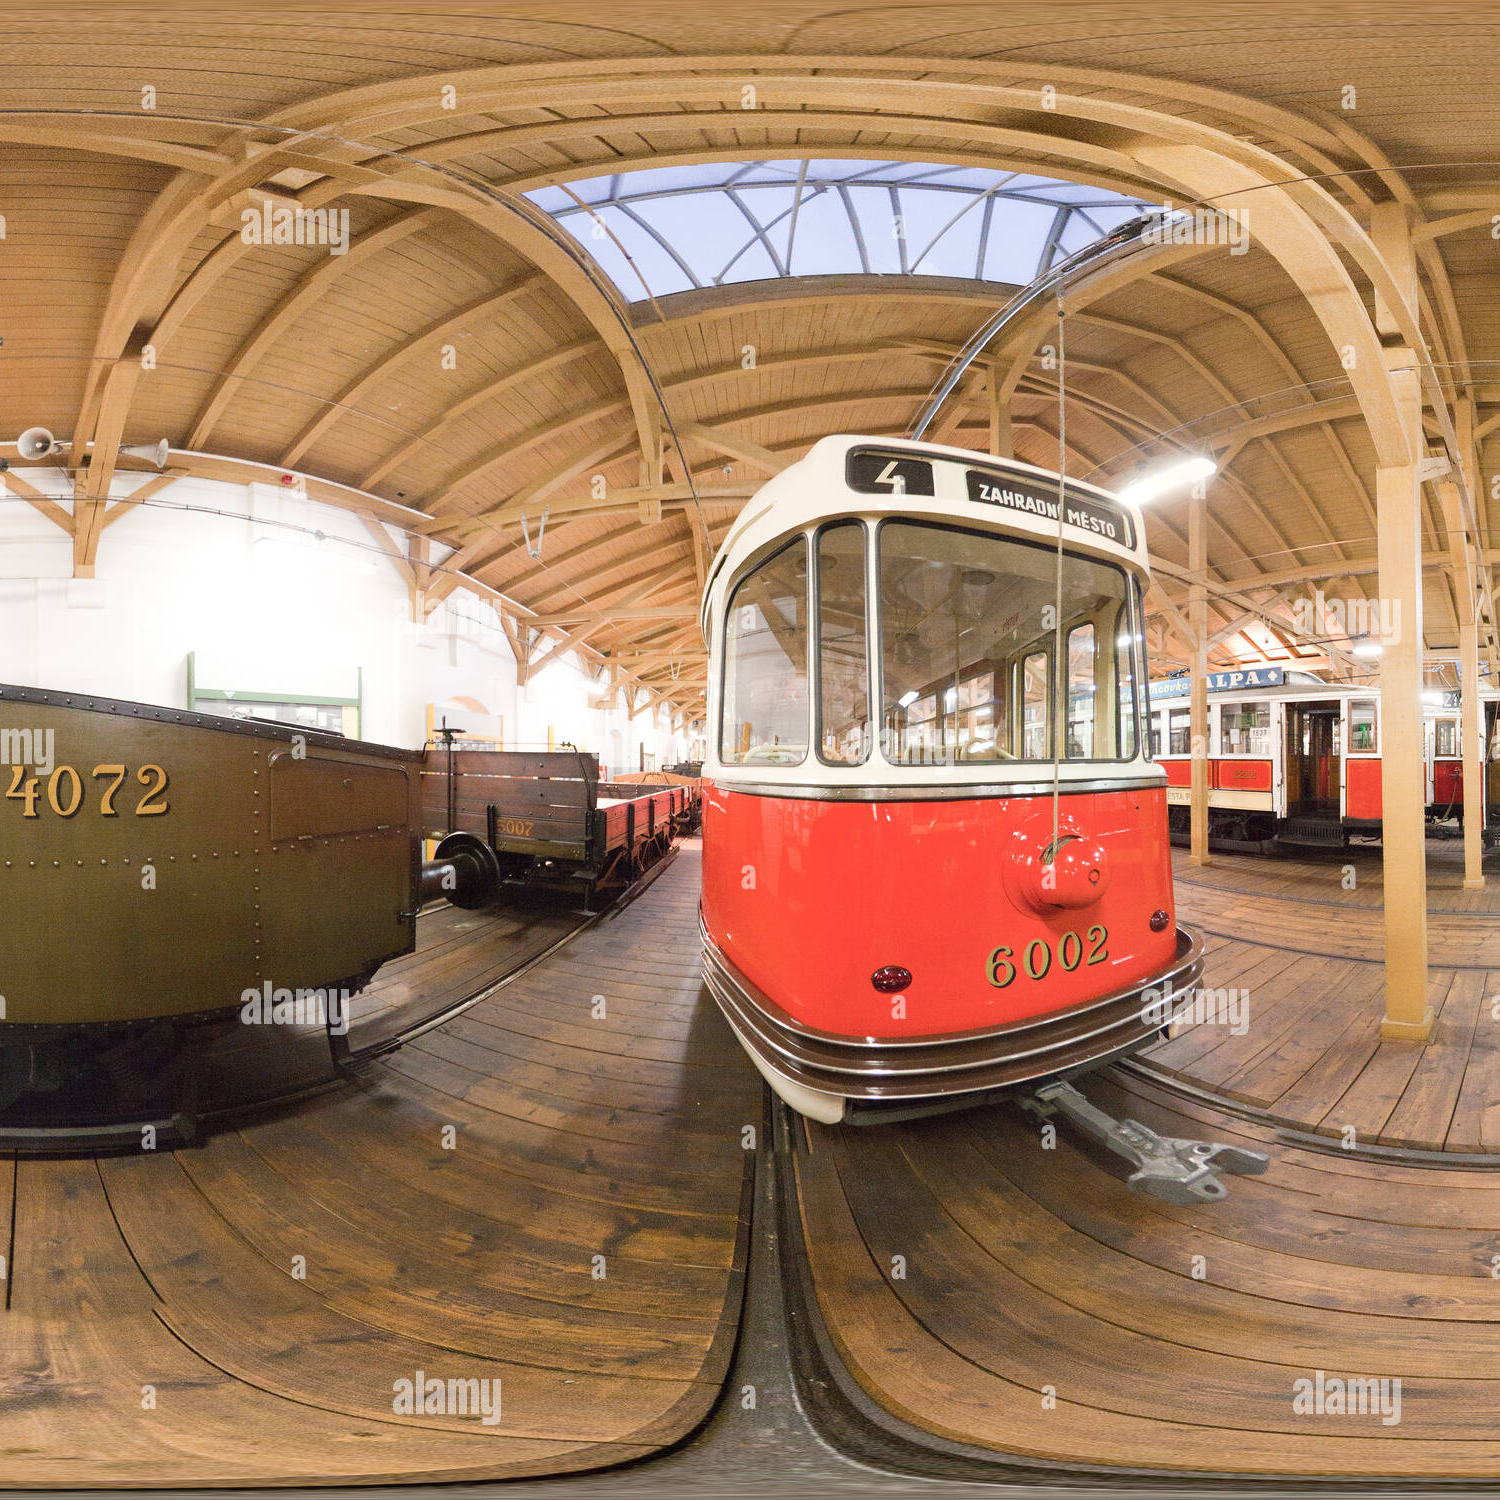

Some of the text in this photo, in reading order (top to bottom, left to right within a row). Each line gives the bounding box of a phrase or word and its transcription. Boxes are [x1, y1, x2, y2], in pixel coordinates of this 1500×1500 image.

[874, 461, 902, 495] 4
[5, 763, 170, 818] 4072
[497, 818, 533, 837] 5007
[984, 923, 1110, 989] 6002
